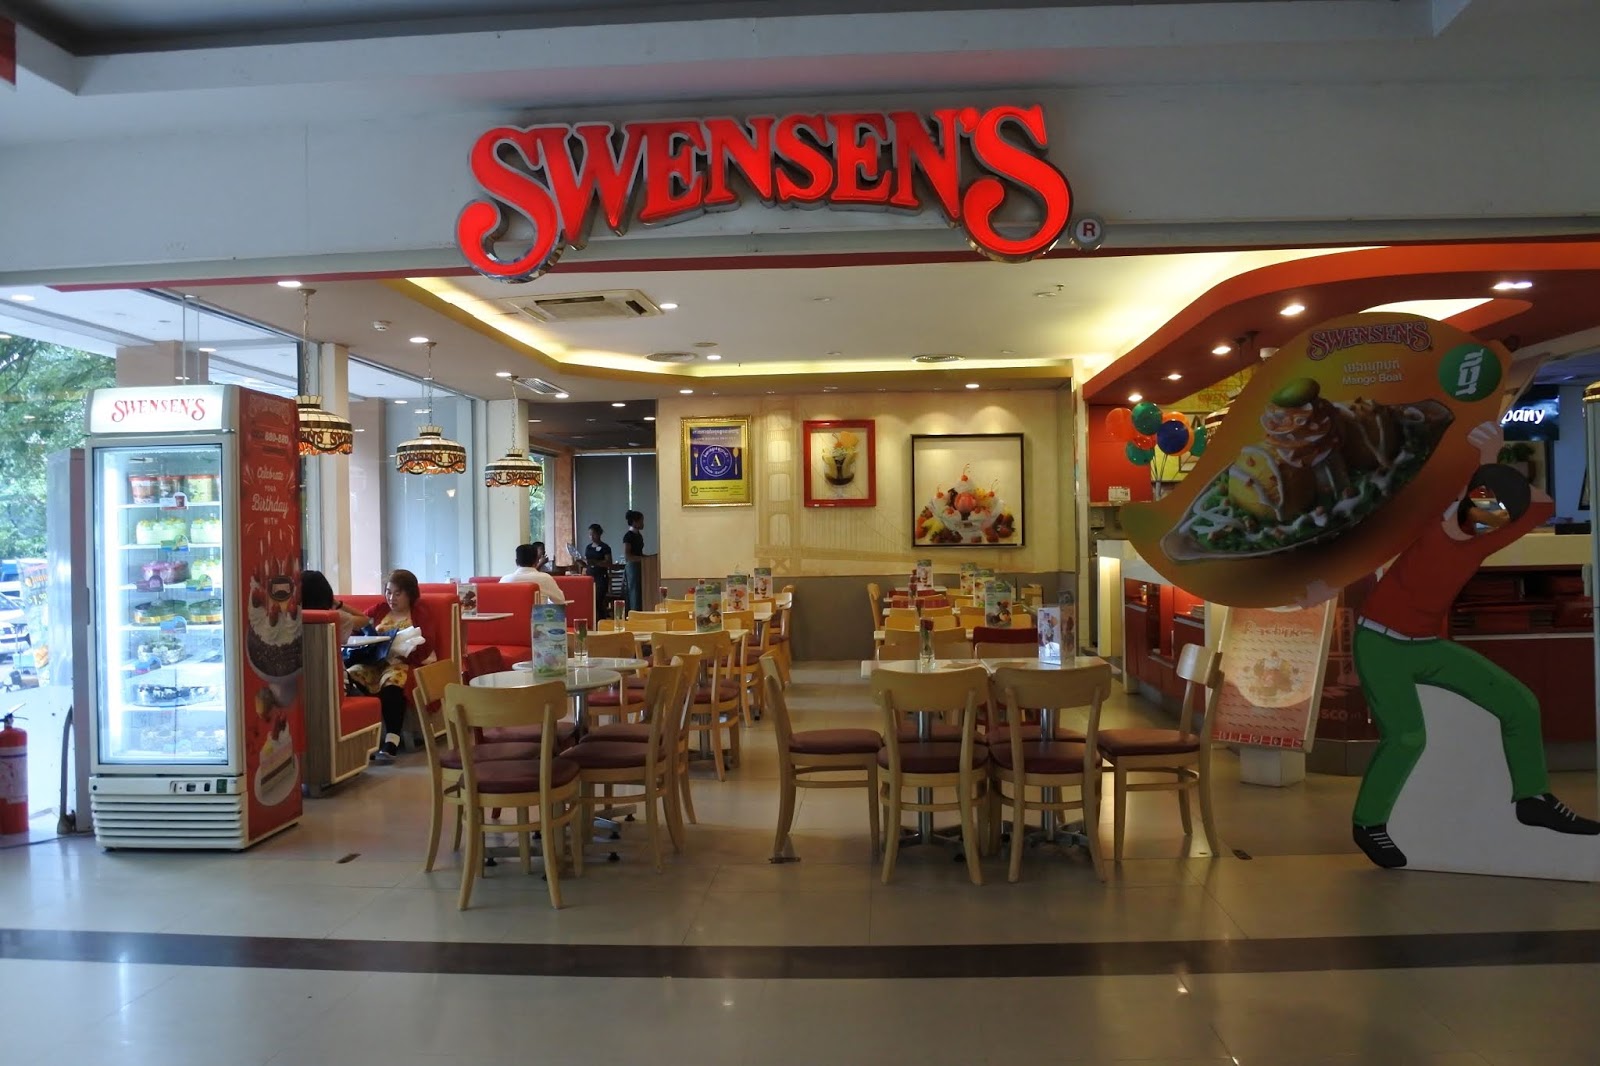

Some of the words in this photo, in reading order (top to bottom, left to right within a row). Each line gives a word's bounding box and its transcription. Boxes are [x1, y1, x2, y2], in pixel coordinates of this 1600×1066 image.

[457, 104, 1073, 277] SWENSEN'S
[1306, 321, 1431, 361] SWENSEN'S
[1342, 376, 1376, 386] Mango
[1379, 373, 1403, 383] Boat
[111, 398, 206, 423] SWENSEN'S
[257, 465, 284, 481] Celebrate
[251, 493, 289, 519] Birthday
